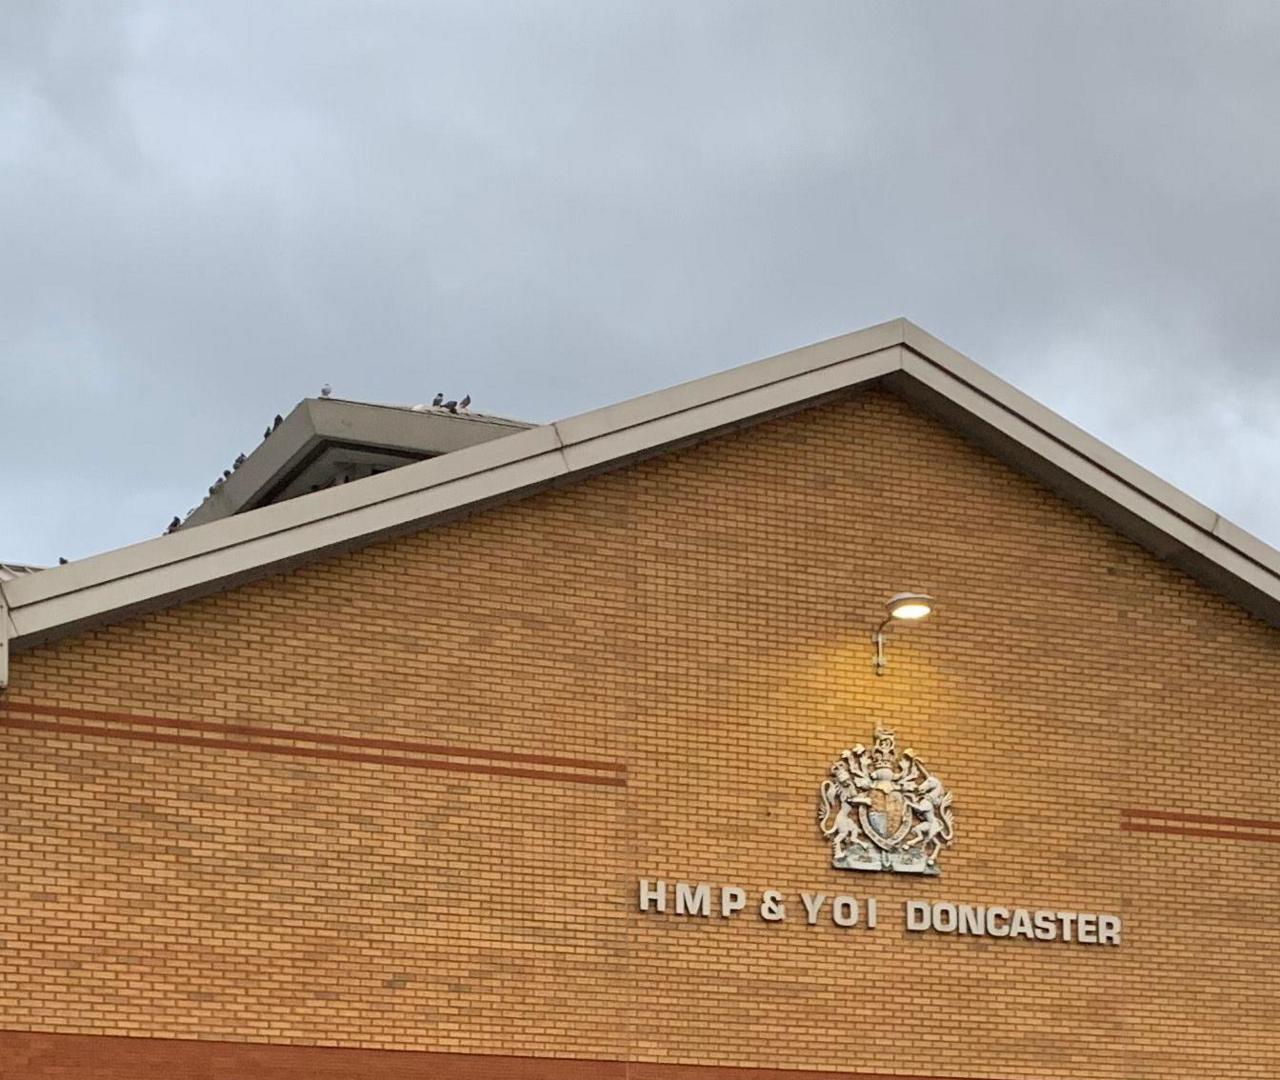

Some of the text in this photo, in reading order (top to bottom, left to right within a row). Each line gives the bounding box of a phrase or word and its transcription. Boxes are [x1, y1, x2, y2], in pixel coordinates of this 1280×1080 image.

[639, 879, 1122, 946] HMP & YOI DONCASTER
